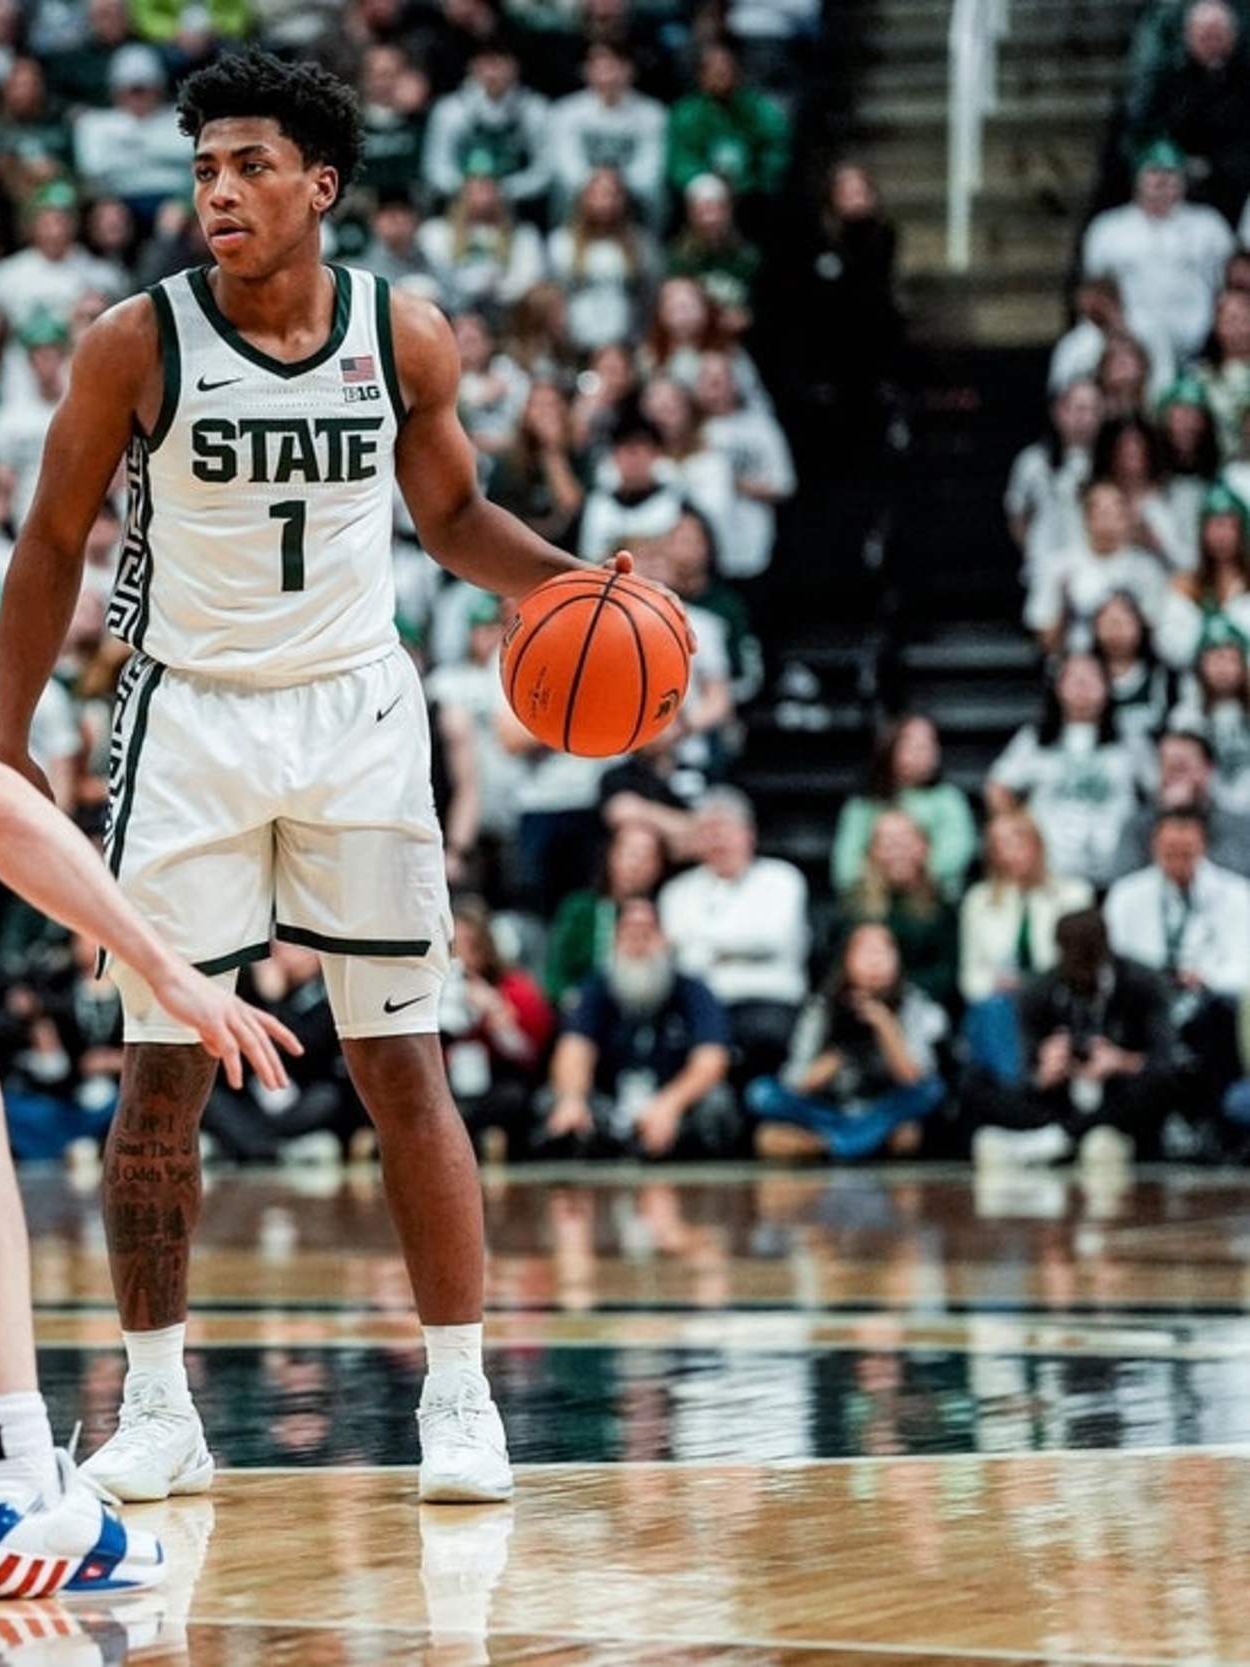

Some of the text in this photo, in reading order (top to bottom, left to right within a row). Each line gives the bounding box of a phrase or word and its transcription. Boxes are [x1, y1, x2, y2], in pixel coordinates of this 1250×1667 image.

[344, 385, 381, 402] B1G
[192, 416, 384, 483] STATE
[269, 500, 307, 592] 1
